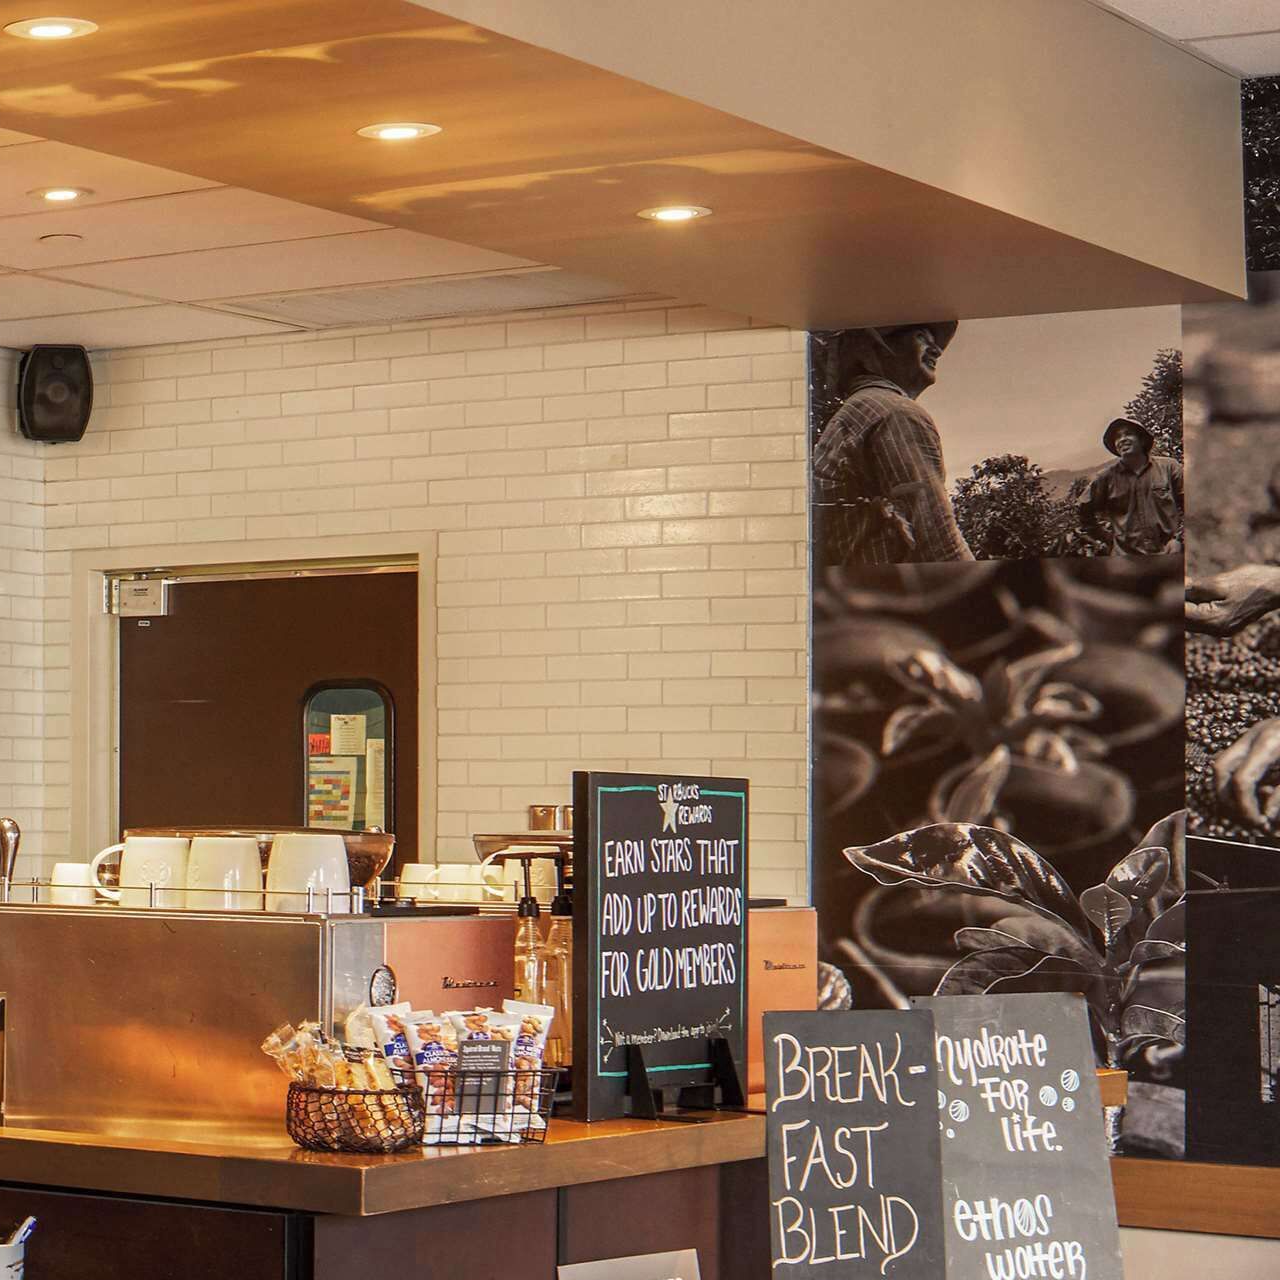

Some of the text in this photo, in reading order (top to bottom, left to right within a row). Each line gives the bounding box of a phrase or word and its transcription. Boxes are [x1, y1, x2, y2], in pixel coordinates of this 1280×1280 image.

[605, 838, 739, 877] EARN STARS THAT
[602, 886, 742, 935] ADD UP TO REWARDS
[602, 943, 736, 998] FOR GOLD MEMBERS
[772, 1032, 927, 1113] BREAK-
[979, 1078, 1036, 1119] FOR
[781, 1119, 889, 1191] FAST
[1001, 1112, 1063, 1152] life.
[772, 1194, 919, 1275] BLEND
[954, 1194, 1052, 1241] ethos
